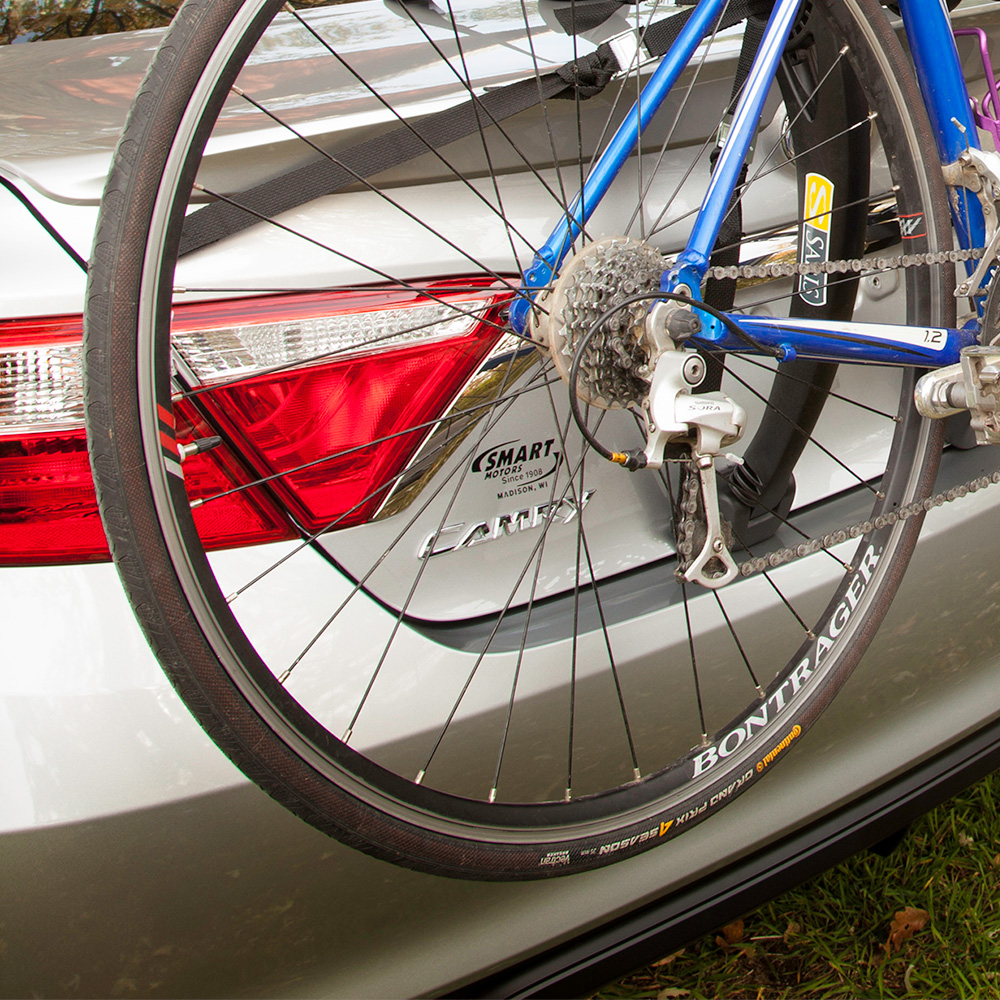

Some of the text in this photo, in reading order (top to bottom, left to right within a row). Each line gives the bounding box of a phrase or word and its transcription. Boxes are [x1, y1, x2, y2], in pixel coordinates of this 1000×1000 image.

[803, 229, 825, 299] SAIS
[923, 330, 942, 343] 1.2
[484, 438, 556, 472] SMART
[484, 464, 523, 481] MOTORS
[502, 468, 543, 485] Since 1908
[538, 481, 549, 489] WI
[691, 545, 882, 780] BONTRAGER
[762, 724, 802, 768] Continental
[709, 768, 754, 806] GRAND
[675, 801, 708, 828] PRIX
